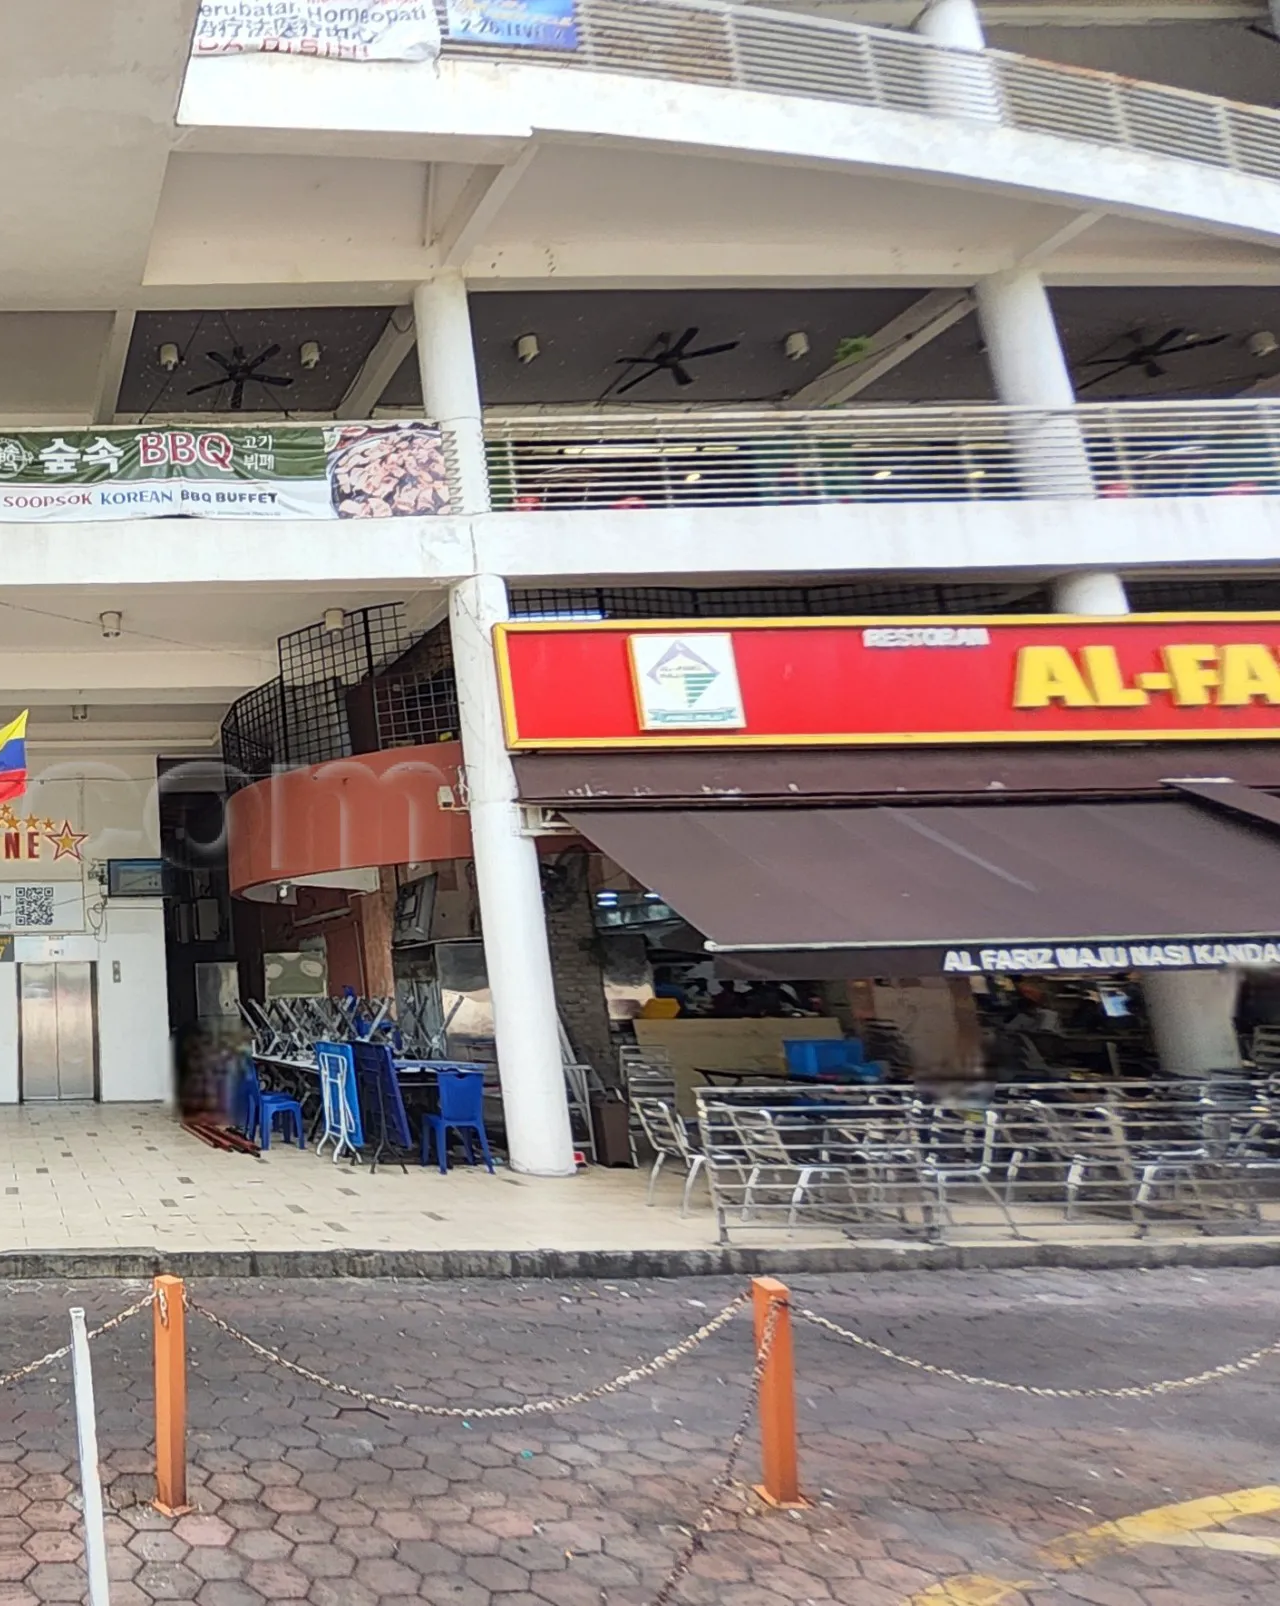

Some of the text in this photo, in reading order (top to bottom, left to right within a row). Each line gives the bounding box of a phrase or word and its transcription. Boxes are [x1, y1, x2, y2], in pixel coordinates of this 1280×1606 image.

[136, 431, 235, 472] BBQ
[242, 434, 273, 450] 고기
[38, 437, 125, 474] 숲속
[243, 452, 275, 471] 뷔페
[3, 489, 278, 509] SOOPSOK KOREAN BBQ BUFFET
[943, 949, 982, 972] AL
[1128, 944, 1195, 967] NASI
